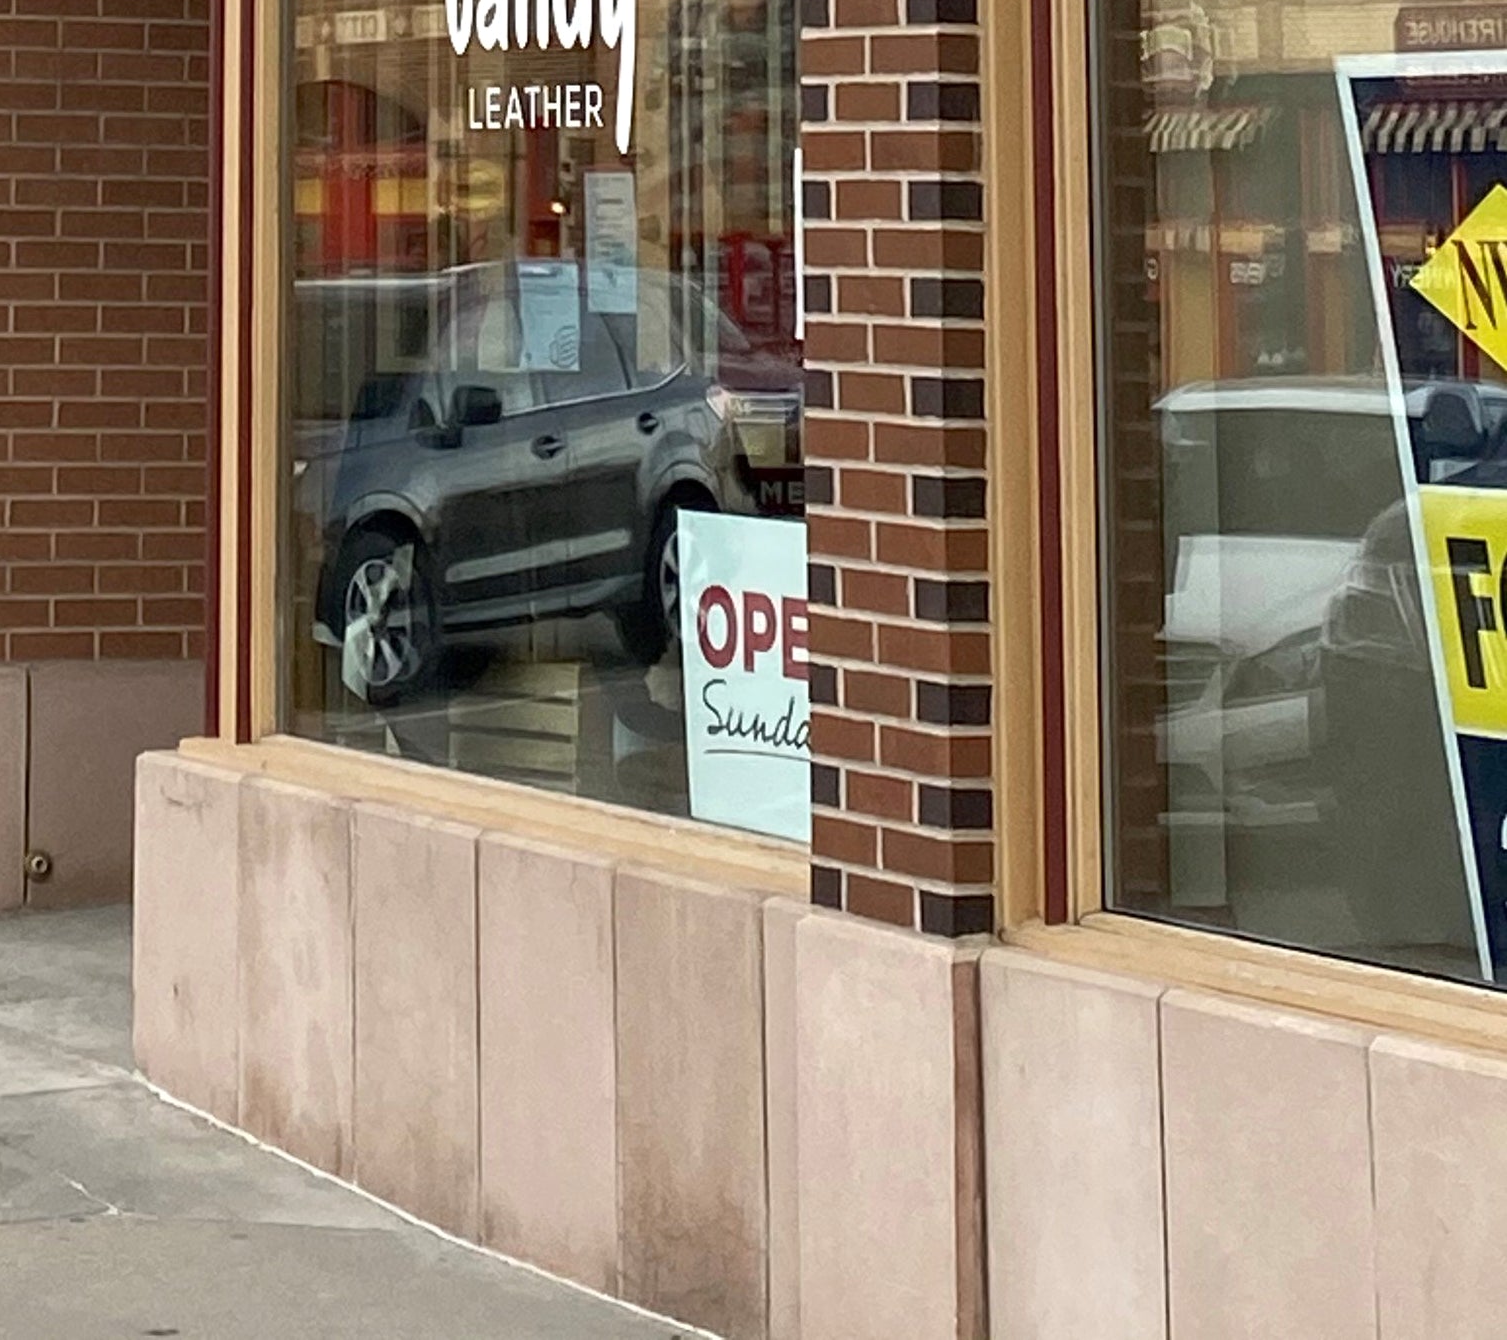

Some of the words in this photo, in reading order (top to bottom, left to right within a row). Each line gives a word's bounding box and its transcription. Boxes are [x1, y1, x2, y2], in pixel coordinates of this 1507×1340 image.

[467, 84, 605, 130] LEATHER
[697, 584, 808, 681] OPE
[1445, 537, 1507, 690] F
